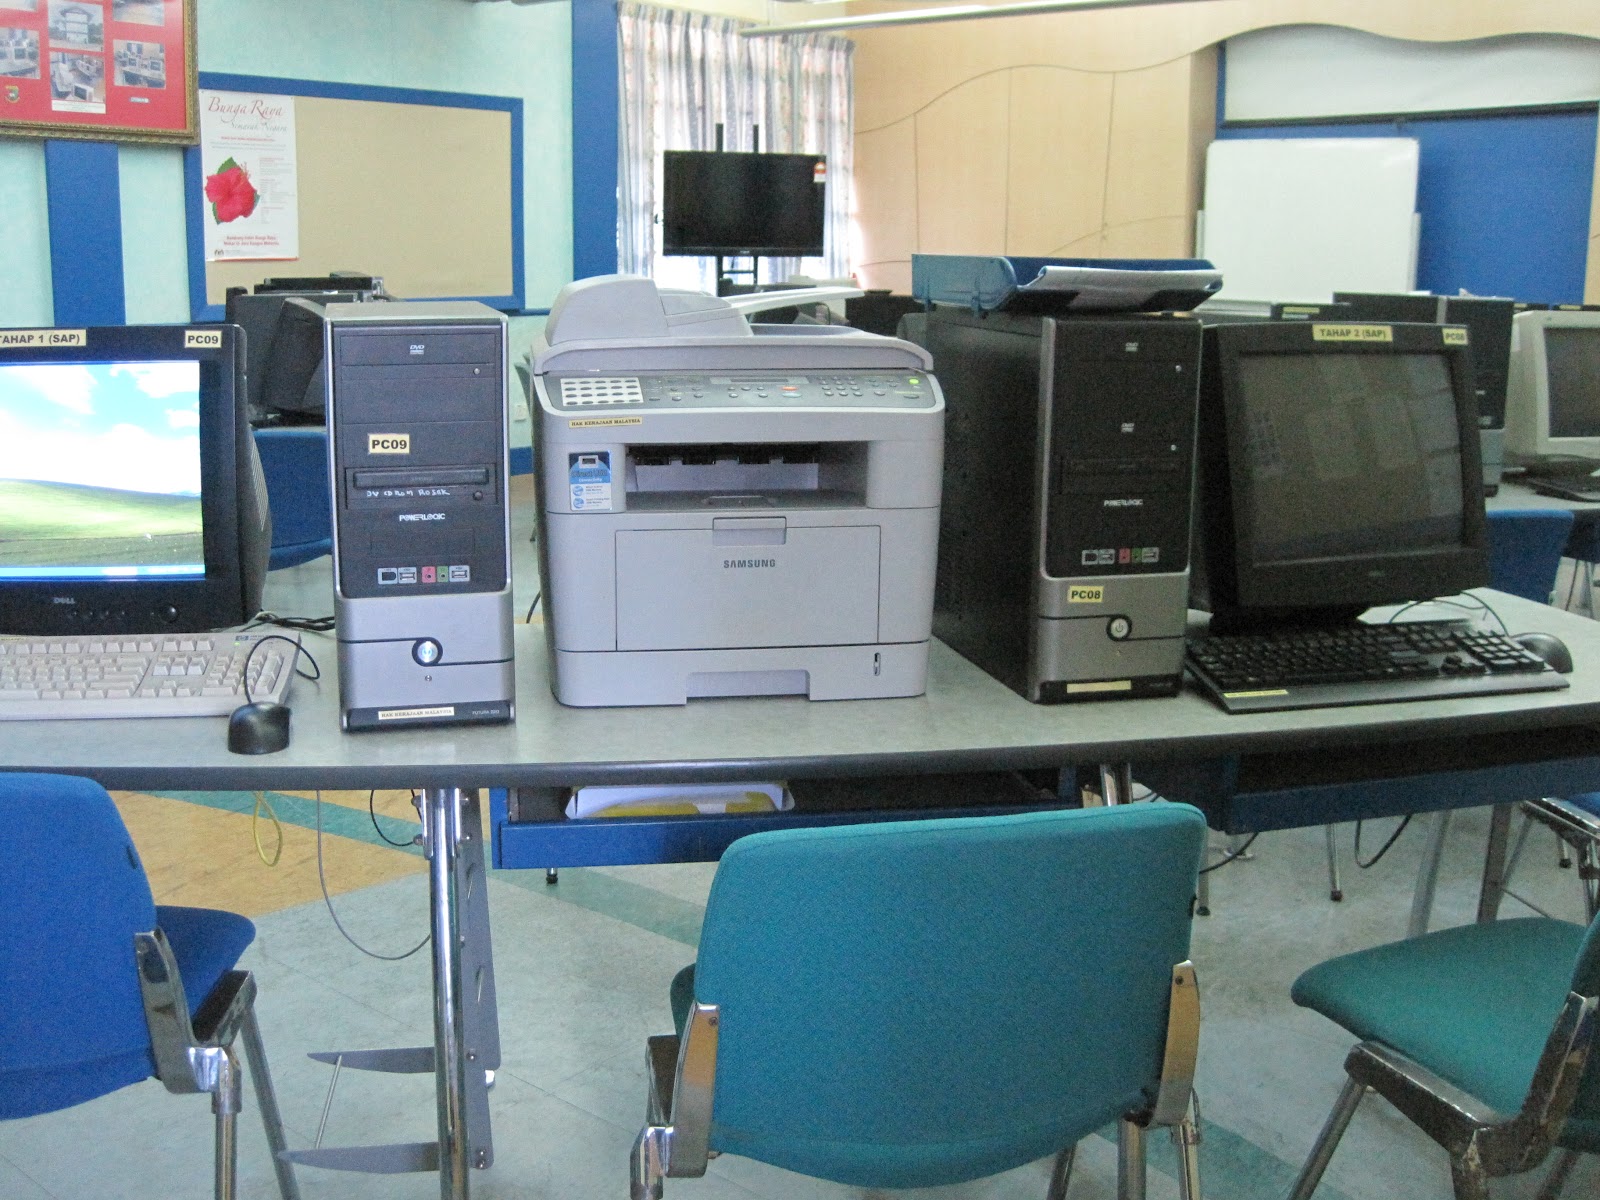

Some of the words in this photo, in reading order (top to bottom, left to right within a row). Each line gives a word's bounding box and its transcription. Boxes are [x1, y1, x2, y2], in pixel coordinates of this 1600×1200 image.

[208, 96, 247, 123] Bunga
[250, 99, 283, 120] Raya
[38, 334, 45, 343] 1
[48, 333, 80, 345] (SAP)
[1319, 328, 1350, 338] TAHAP
[1354, 329, 1360, 338] 2
[1362, 329, 1387, 340] (SAP)
[187, 335, 219, 345] PC09
[371, 439, 408, 450] PC09
[723, 559, 776, 569] SAMSUNG
[1071, 590, 1102, 600] PC08
